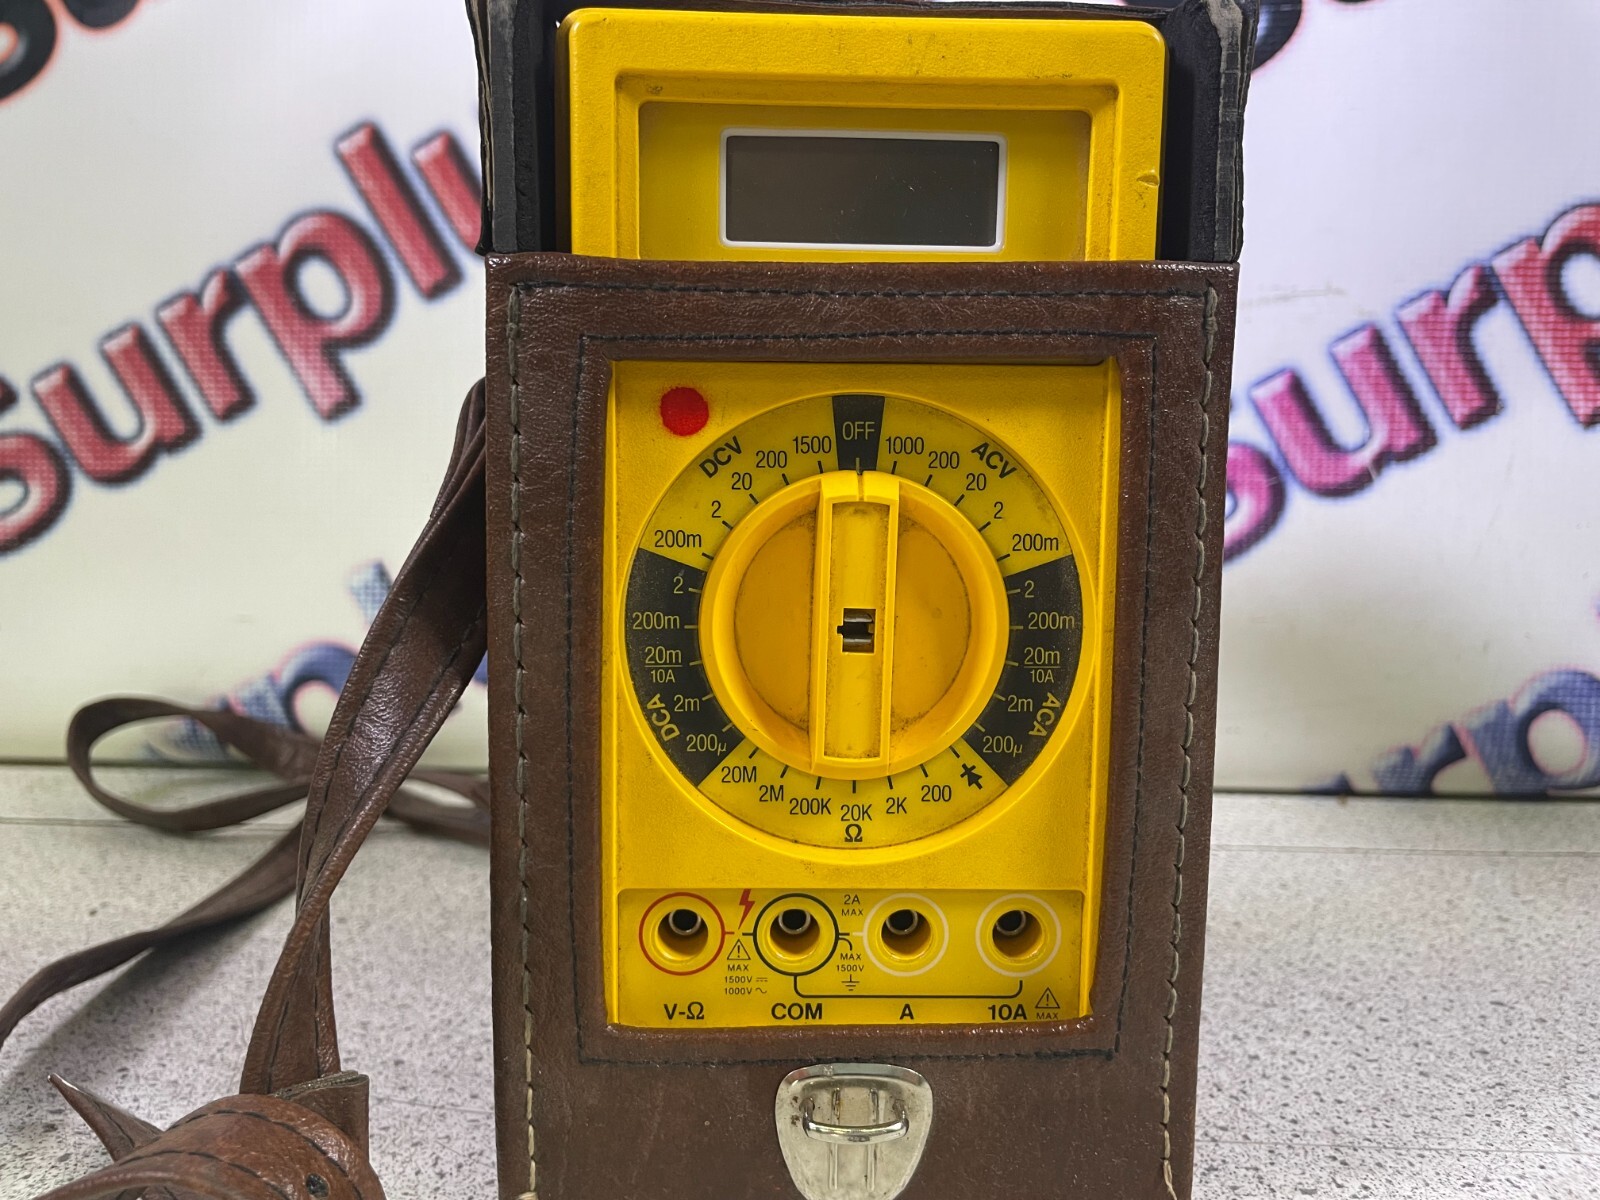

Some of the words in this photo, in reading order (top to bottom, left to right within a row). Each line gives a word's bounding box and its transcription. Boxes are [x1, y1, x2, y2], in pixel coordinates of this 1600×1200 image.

[842, 421, 876, 441] OFF
[792, 435, 832, 455] 1500
[885, 436, 925, 455] 1000
[698, 435, 743, 479] DCV
[755, 450, 788, 469] 200
[928, 450, 960, 470] 200
[971, 441, 1018, 480] ACV
[731, 472, 753, 491] 20
[965, 472, 987, 491] 20
[711, 500, 722, 519] 2
[993, 501, 1004, 520] 2
[653, 529, 702, 548] 200m
[1011, 533, 1060, 552] 200m
[673, 575, 684, 595] 2
[1023, 579, 1035, 598] 2
[631, 611, 681, 630] 200m
[1027, 611, 1076, 630] 200m
[644, 645, 683, 664] 20m
[1023, 646, 1061, 665] 20m
[650, 668, 676, 684] 10A
[1029, 668, 1055, 684] 10A
[673, 694, 700, 712] 2m
[1006, 694, 1034, 713] 2m
[646, 692, 681, 742] DCA
[1027, 691, 1062, 738] ACA
[720, 765, 758, 784] 20M
[758, 783, 785, 803] 2M
[920, 784, 952, 803] 200
[788, 797, 832, 816] 200K
[839, 803, 873, 822] 20K
[885, 796, 908, 815] 2K
[843, 894, 861, 906] 2A
[841, 908, 864, 917] MAX
[839, 952, 862, 961] MAX
[727, 964, 750, 972] MAX
[835, 964, 865, 973] 1500V
[724, 975, 753, 984] 1500V
[724, 987, 753, 996] 1000V
[770, 1002, 824, 1021] COM
[899, 1003, 915, 1021] A
[987, 1003, 1028, 1022] 10A
[1035, 1011, 1060, 1021] MAX
